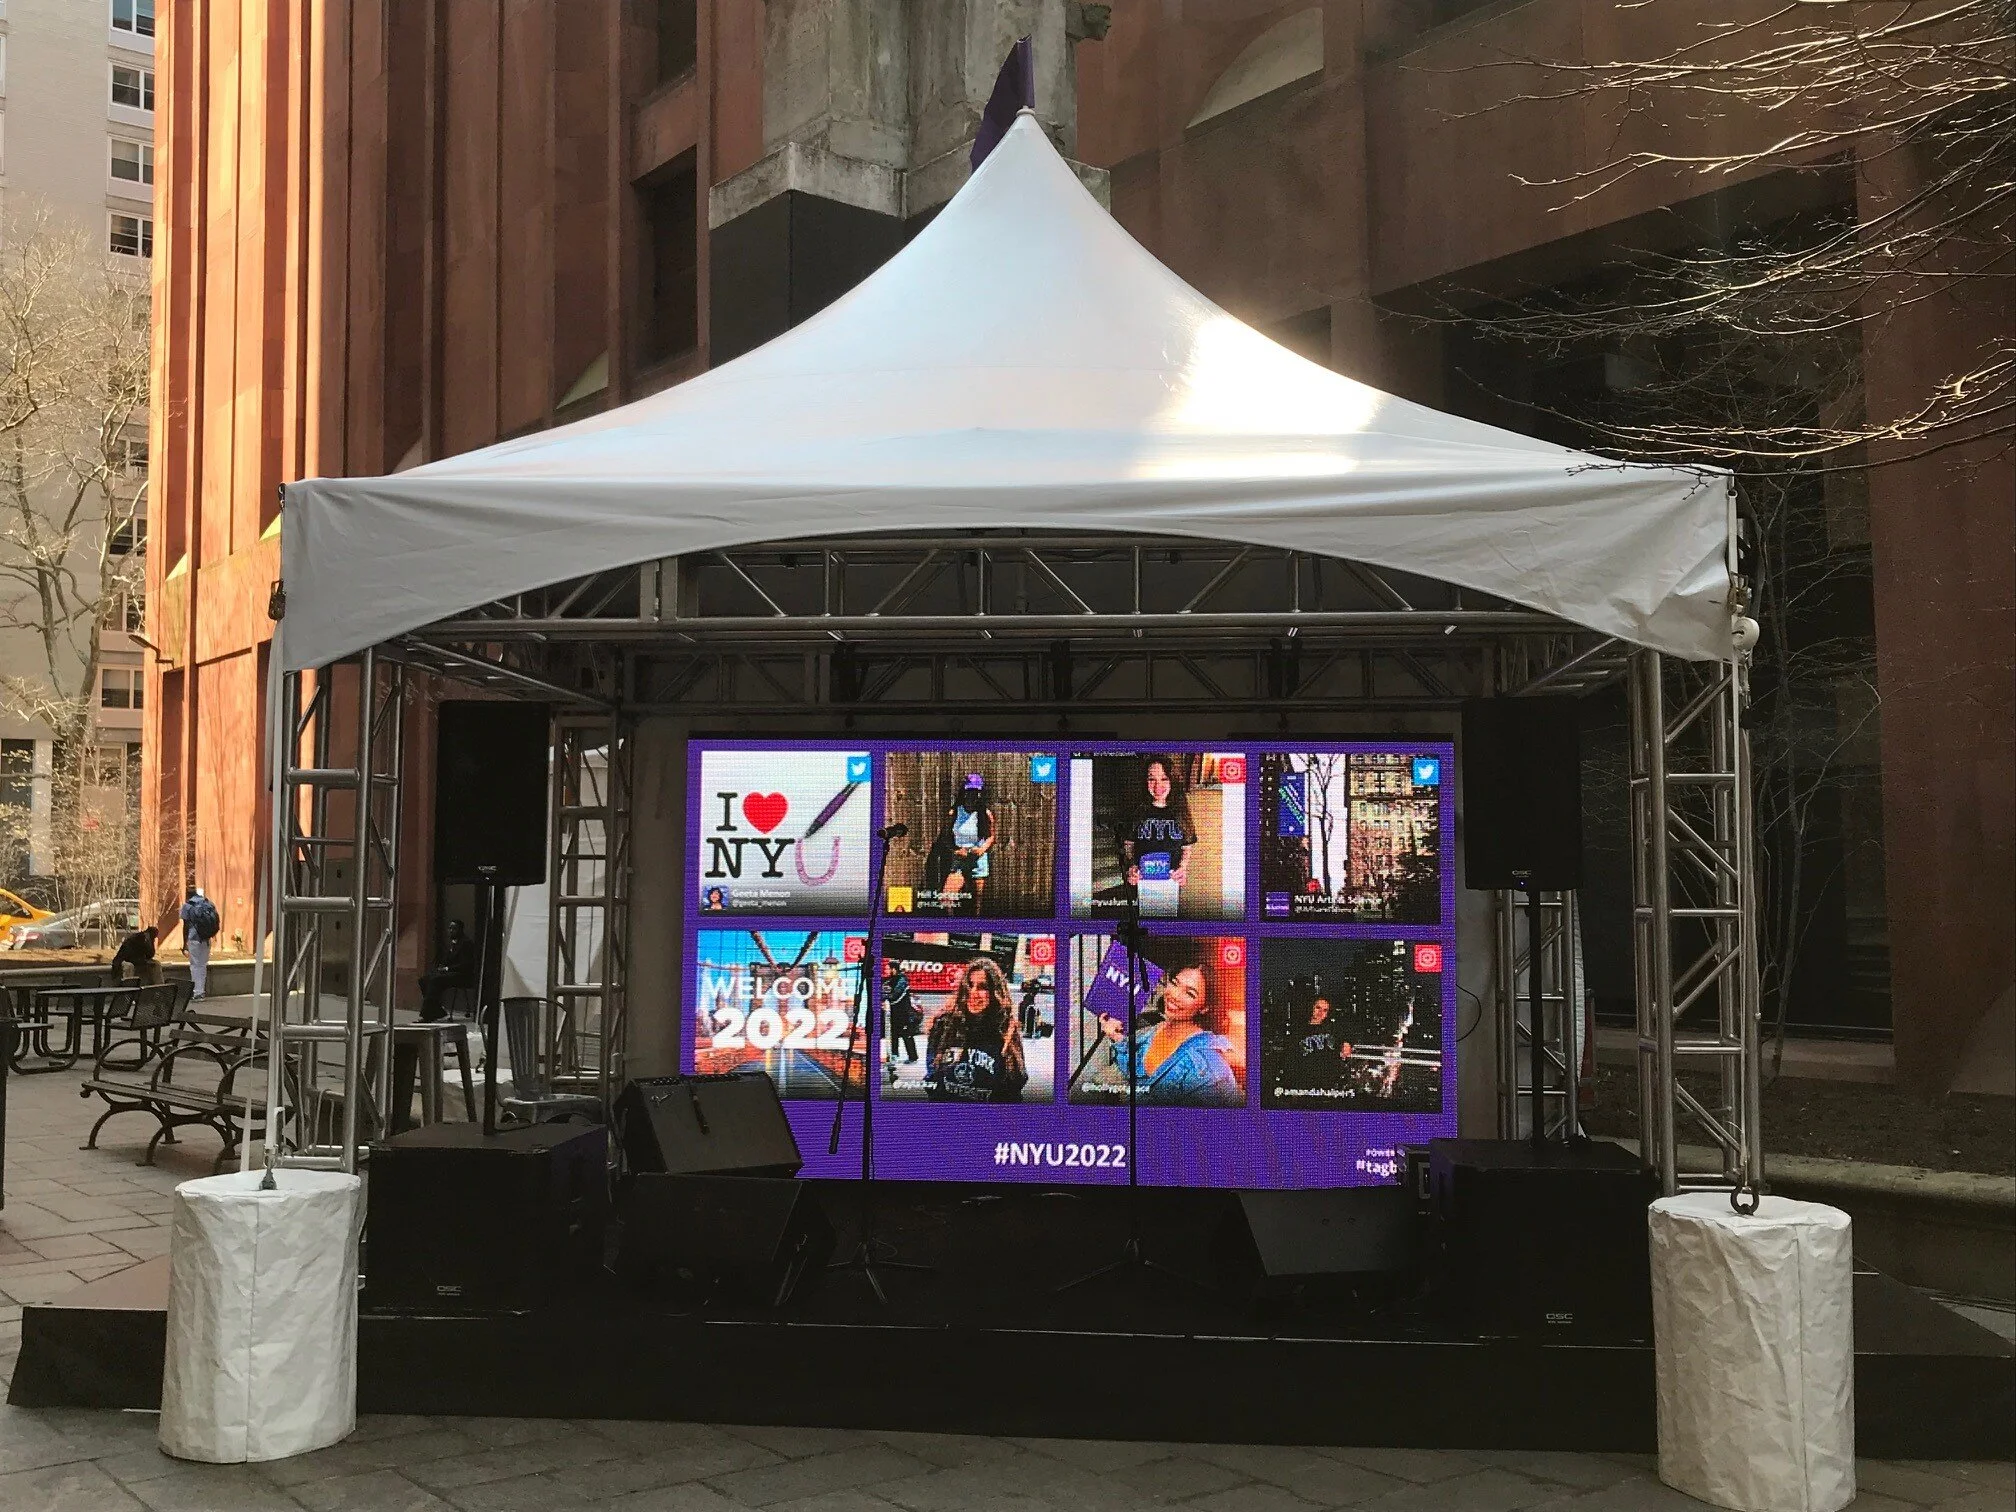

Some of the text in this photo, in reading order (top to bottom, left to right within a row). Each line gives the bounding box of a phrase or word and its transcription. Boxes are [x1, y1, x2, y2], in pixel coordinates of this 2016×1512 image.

[716, 791, 738, 832] I
[700, 975, 856, 1001] WELCOME
[711, 1007, 852, 1050] 2022
[994, 1142, 1126, 1167] #NYU2022
